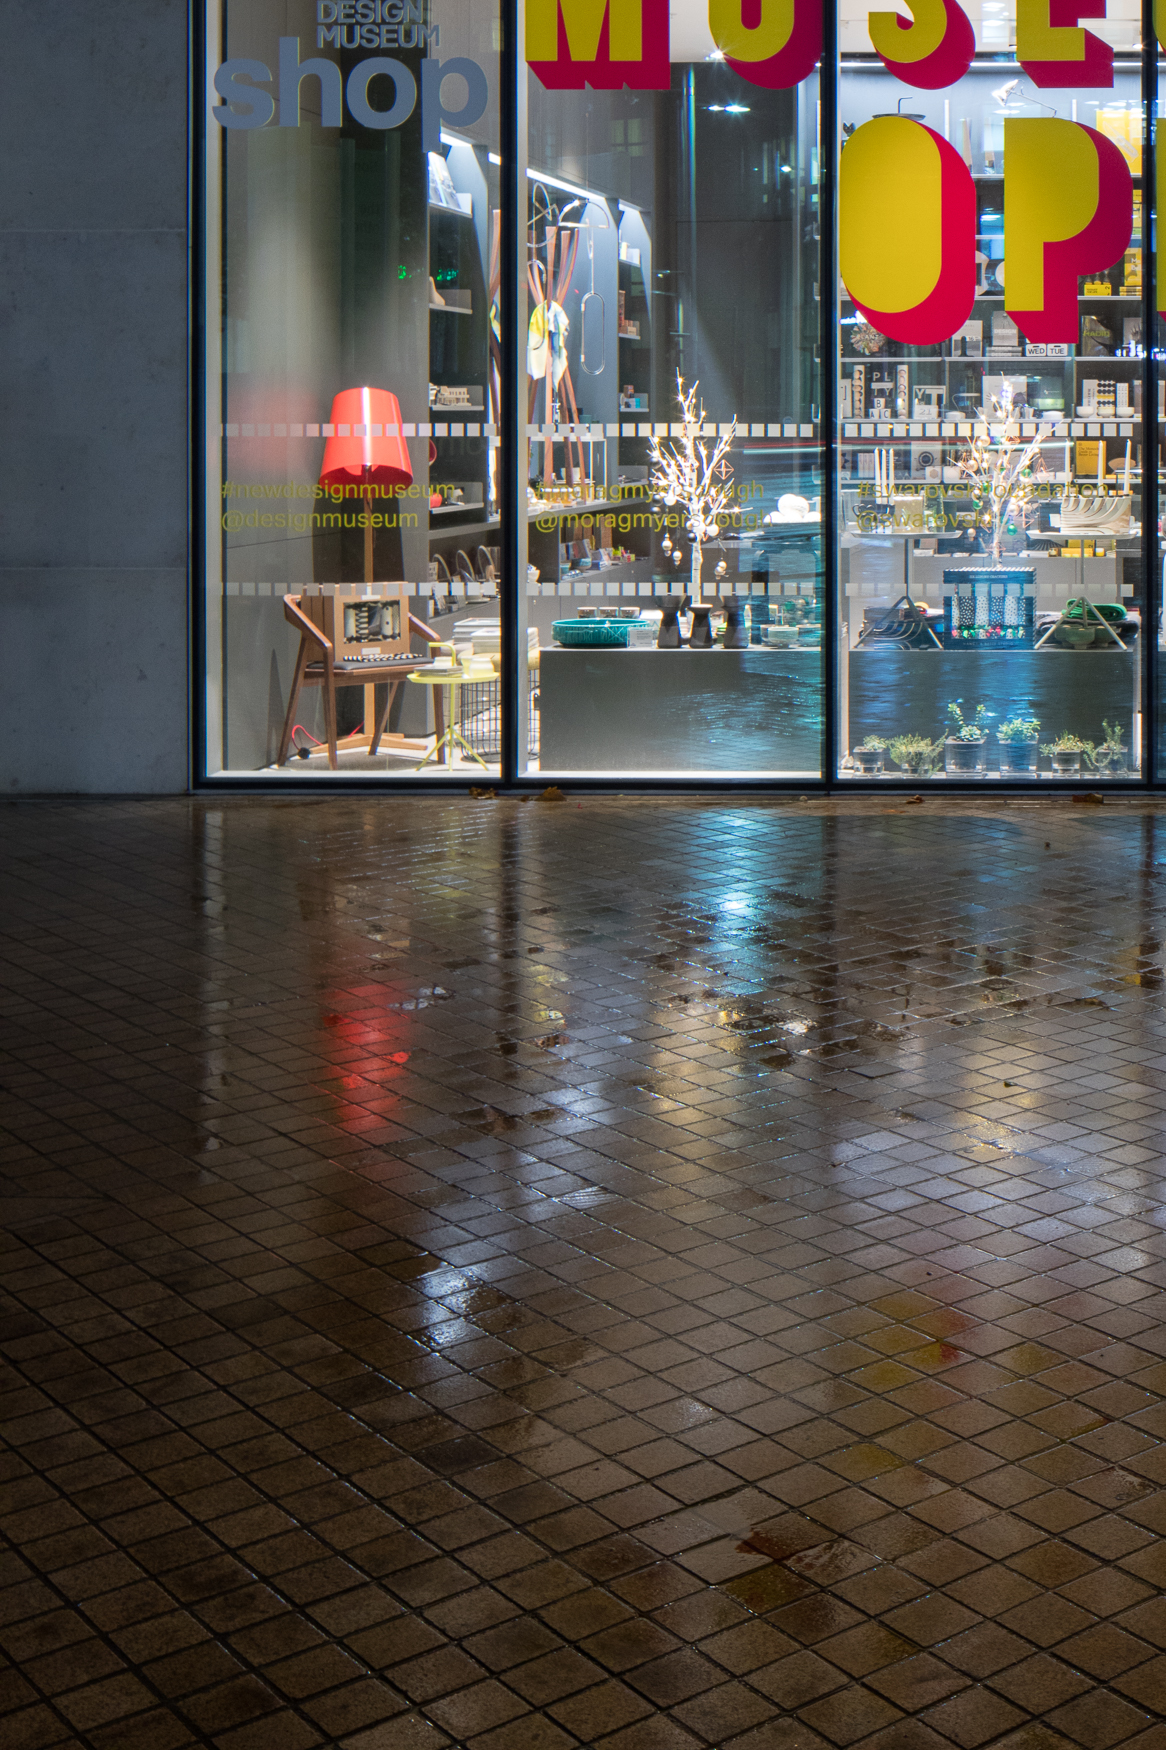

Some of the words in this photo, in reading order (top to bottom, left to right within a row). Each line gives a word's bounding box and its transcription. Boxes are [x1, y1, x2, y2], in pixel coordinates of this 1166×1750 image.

[317, 0, 424, 23] DESIGN
[317, 24, 441, 48] MUSEUM
[212, 37, 489, 153] shop
[1027, 347, 1046, 355] WED
[1049, 347, 1066, 355] TUE
[221, 480, 456, 503] #newdesignmuseum
[536, 480, 764, 504] #moragmyough
[221, 509, 419, 533] @designmuseum
[535, 509, 773, 533] @moragmyersough
